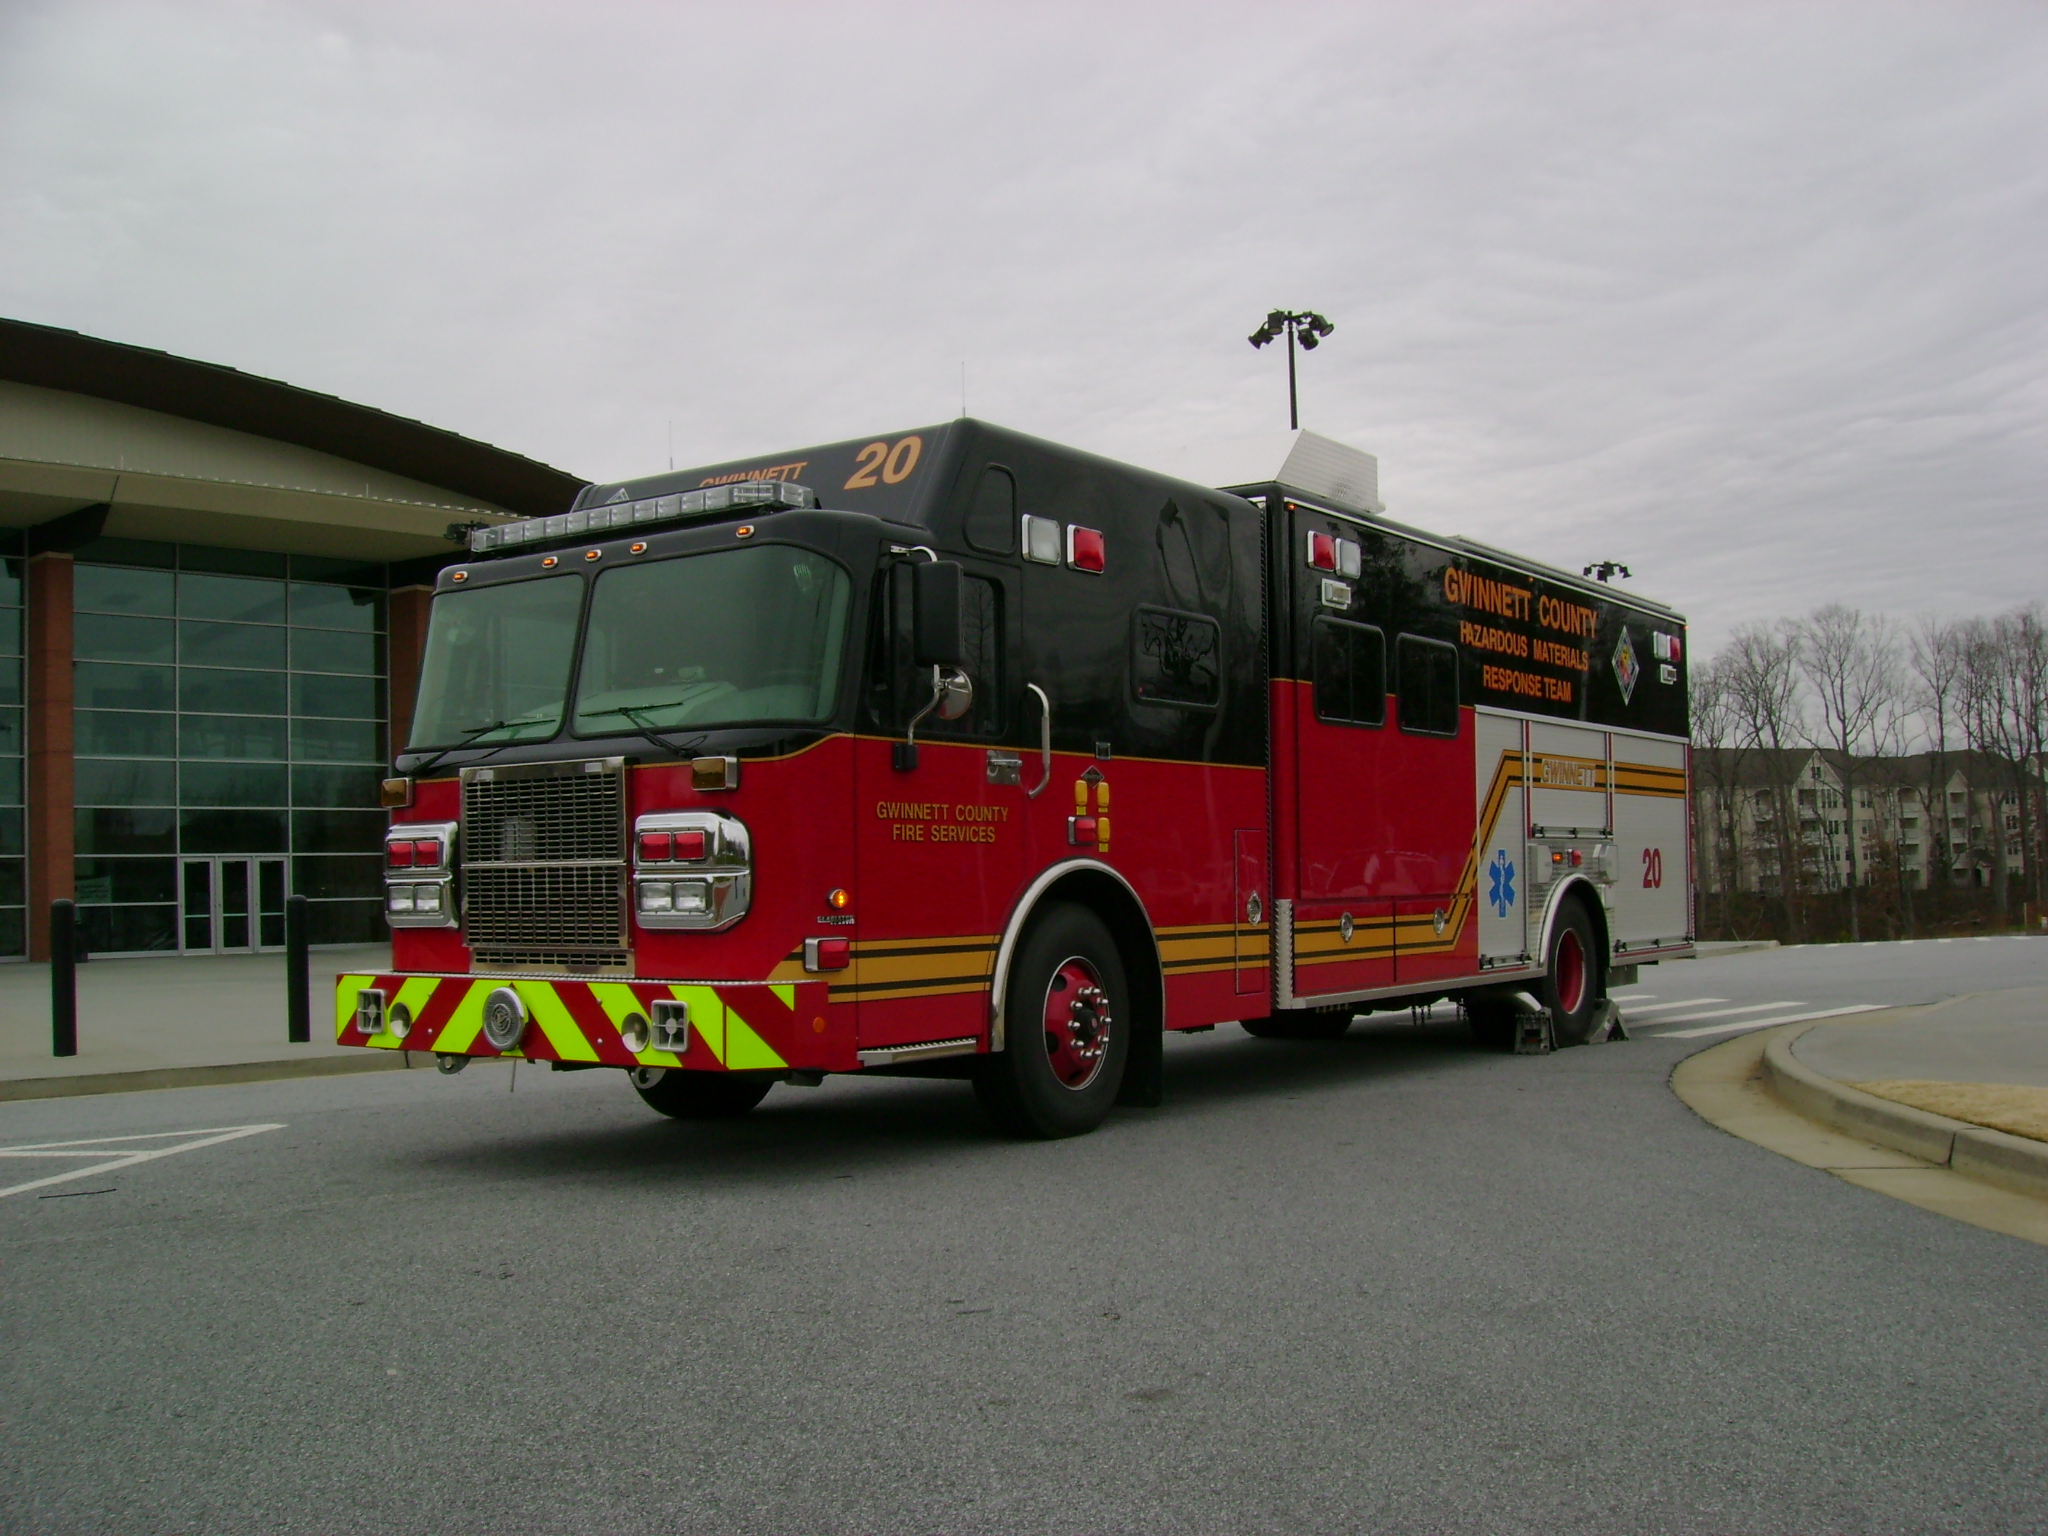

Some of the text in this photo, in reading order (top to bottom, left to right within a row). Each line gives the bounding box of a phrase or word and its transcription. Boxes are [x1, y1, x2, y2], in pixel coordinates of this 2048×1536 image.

[843, 436, 922, 490] 20
[1444, 567, 1598, 638] GWINNETT COUNTY
[1460, 620, 1588, 671] HAZARDOUS MATERIALS
[1483, 665, 1572, 703] RESPONSE TEAM
[1541, 759, 1596, 787] GWINNETT
[876, 801, 1009, 823] GWINNETT COUNTY
[892, 824, 996, 843] FIRE SERVICES
[1642, 848, 1662, 889] 20
